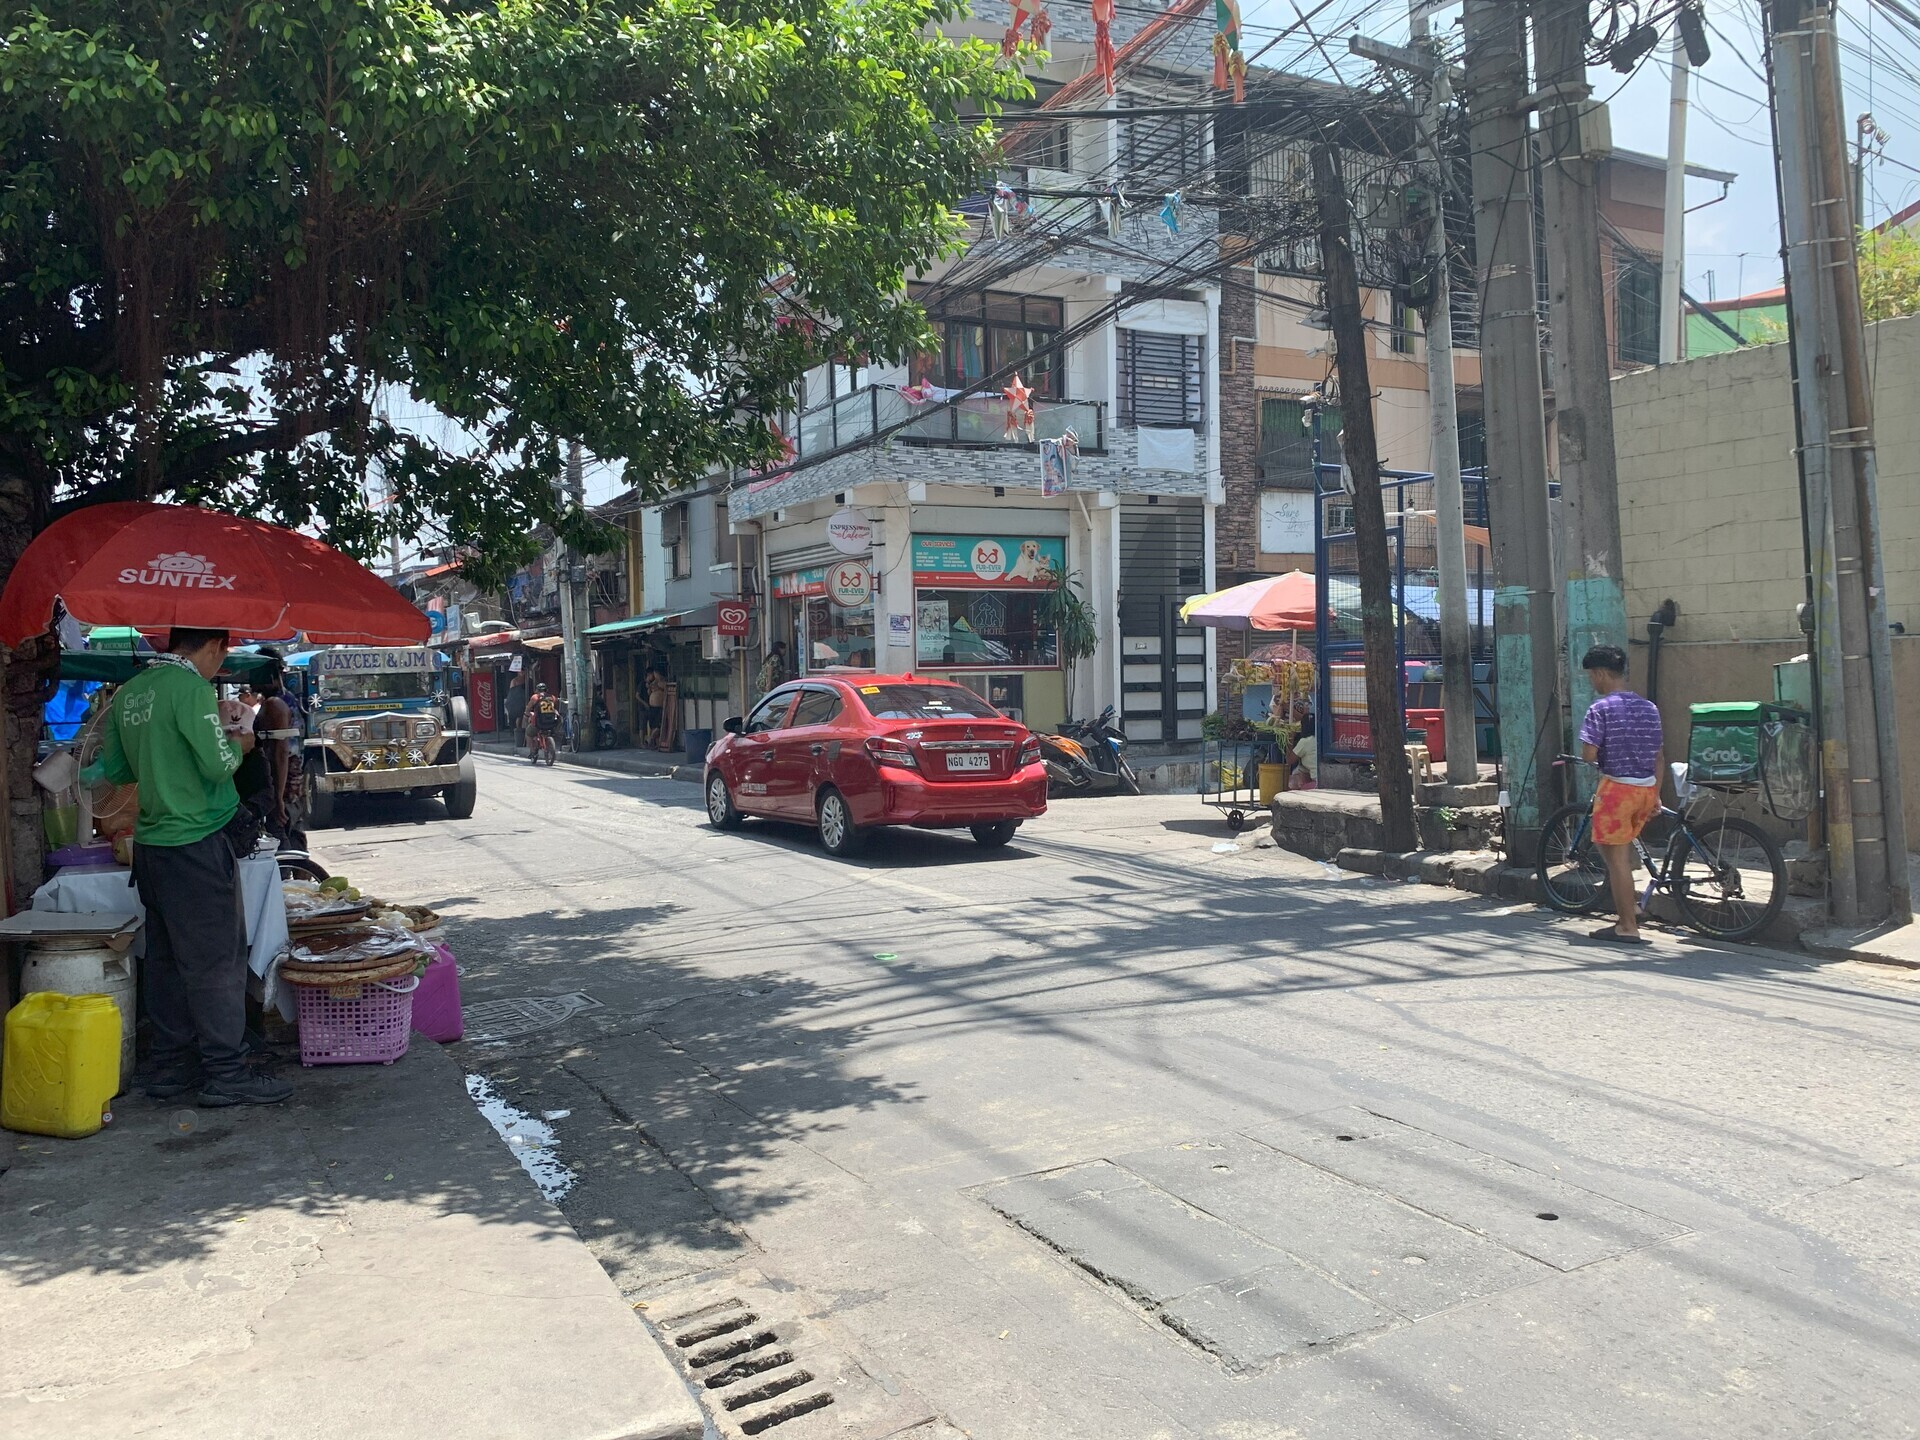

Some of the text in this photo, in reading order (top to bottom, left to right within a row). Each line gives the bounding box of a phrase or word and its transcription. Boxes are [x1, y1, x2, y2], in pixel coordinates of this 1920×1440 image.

[118, 568, 237, 591] SUNTEX
[324, 651, 426, 670] JAYCEE & JM
[477, 680, 492, 719] Coca-Cola
[123, 704, 153, 727] Food
[968, 756, 989, 767] 4275
[1703, 746, 1741, 762] Grab
